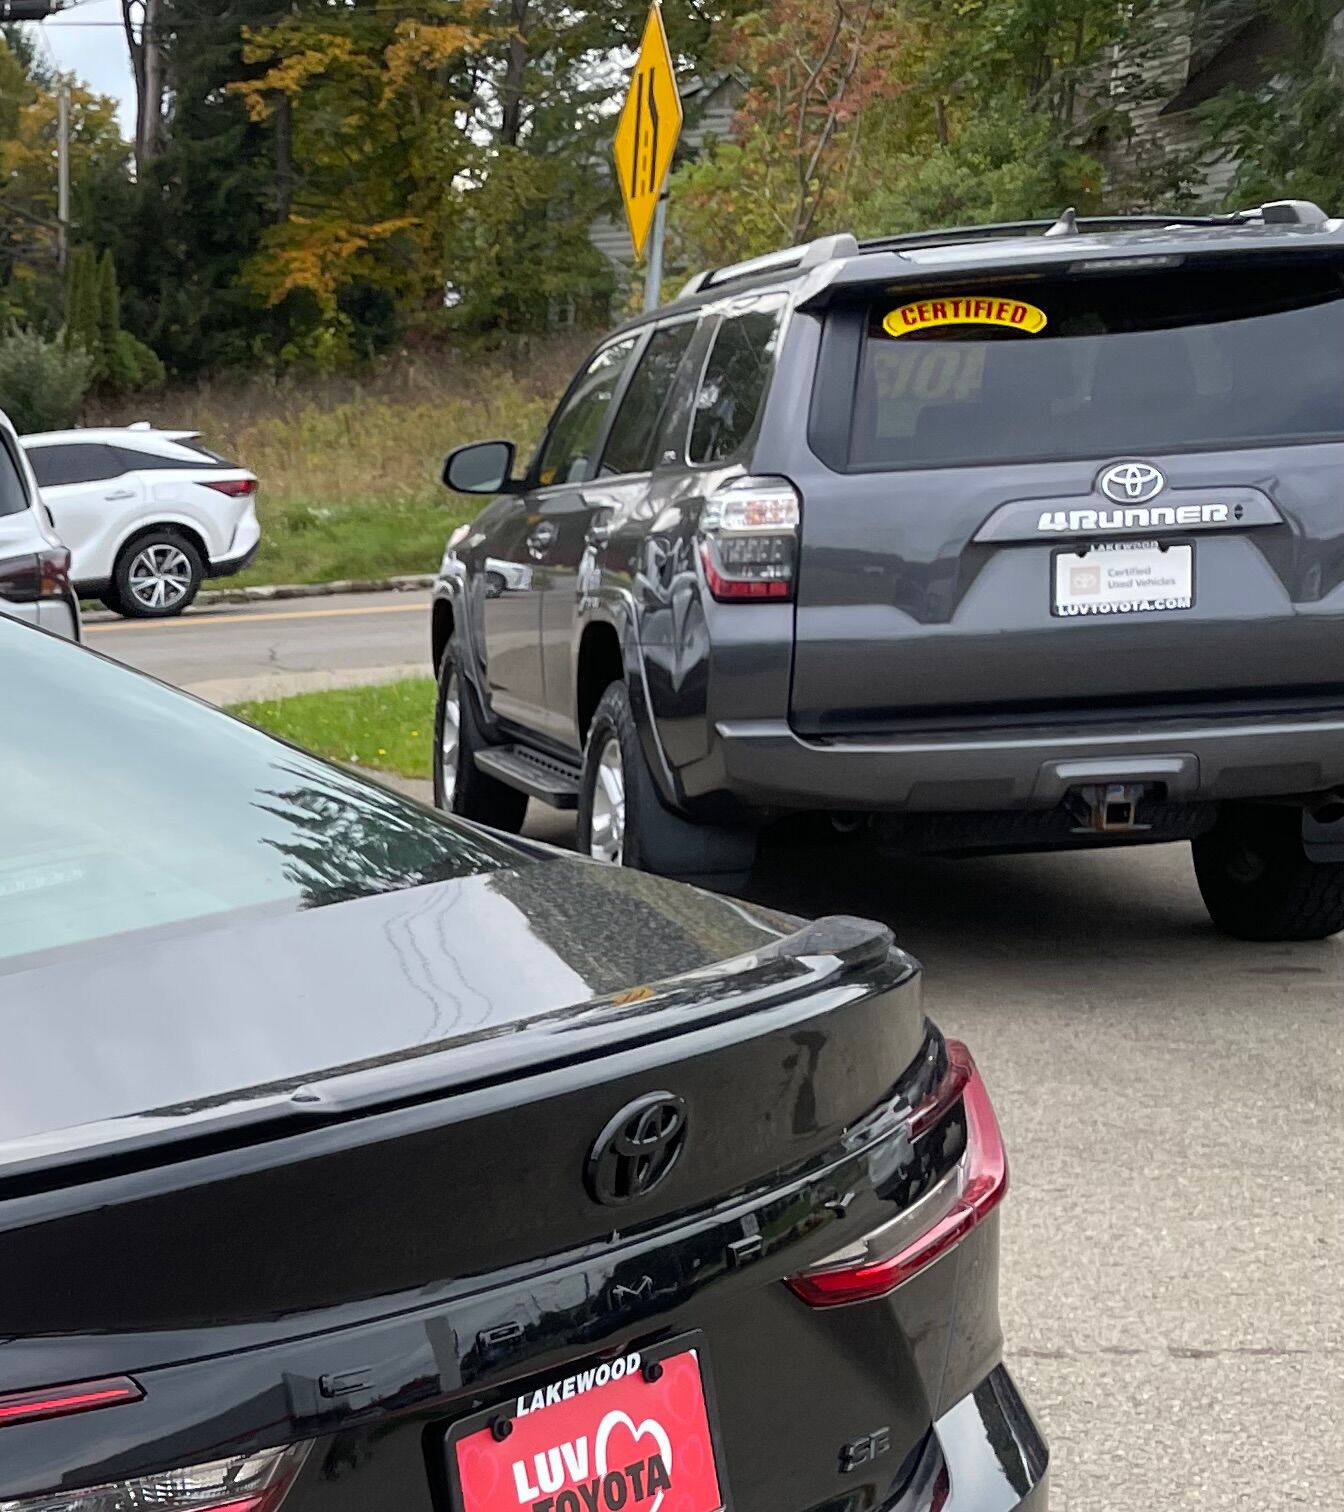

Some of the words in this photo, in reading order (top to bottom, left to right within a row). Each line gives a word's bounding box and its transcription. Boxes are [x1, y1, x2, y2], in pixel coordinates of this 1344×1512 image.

[900, 299, 1028, 326] CERTIFIED
[1037, 504, 1229, 531] 4RUNNER
[1107, 566, 1152, 578] Certified
[1135, 575, 1177, 588] Vehicles
[1056, 597, 1191, 617] LUVTOYOTA.COM
[515, 1351, 642, 1418] LAKEWOOD
[512, 1435, 589, 1504] LUV
